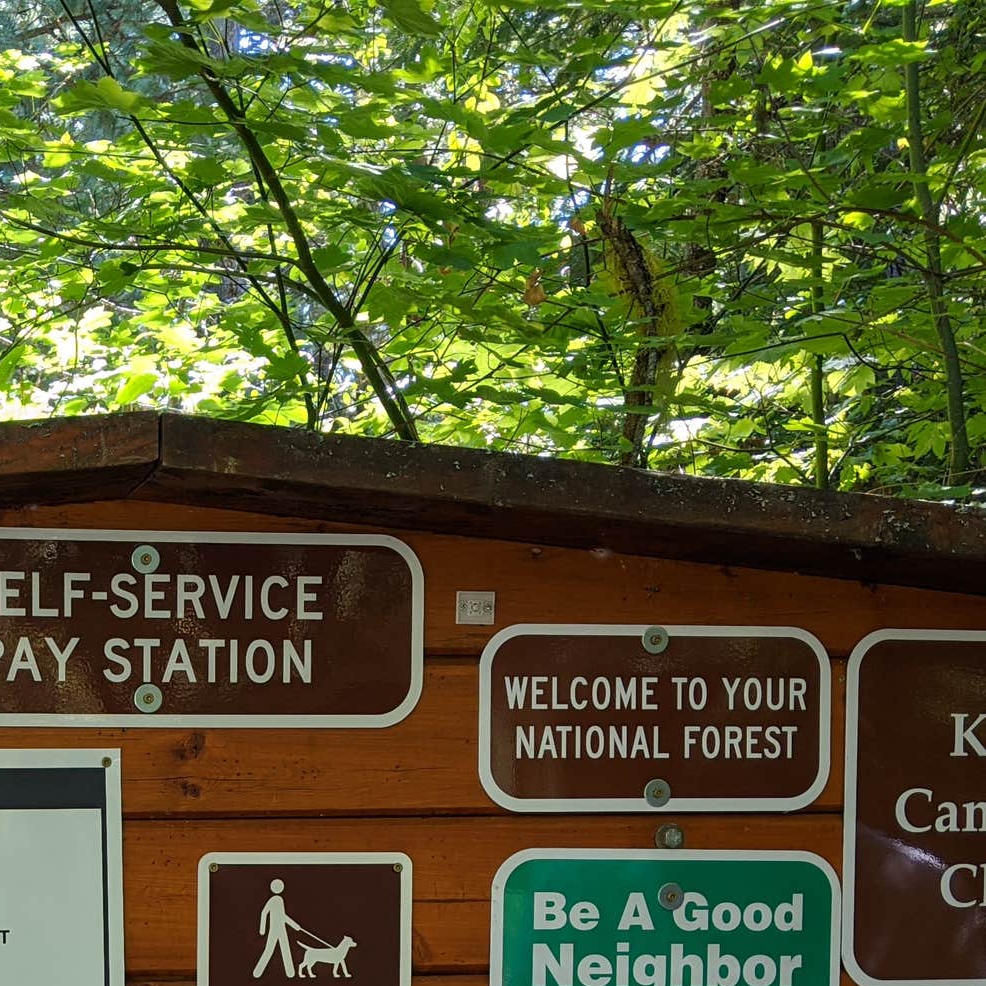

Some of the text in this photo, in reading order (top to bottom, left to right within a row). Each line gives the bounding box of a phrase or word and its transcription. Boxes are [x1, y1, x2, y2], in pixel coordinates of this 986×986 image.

[103, 639, 313, 684] STATION
[504, 676, 806, 710] WELCOME TO YOUR
[516, 725, 798, 759] NATIONAL FOREST
[532, 891, 804, 931] Be A Good
